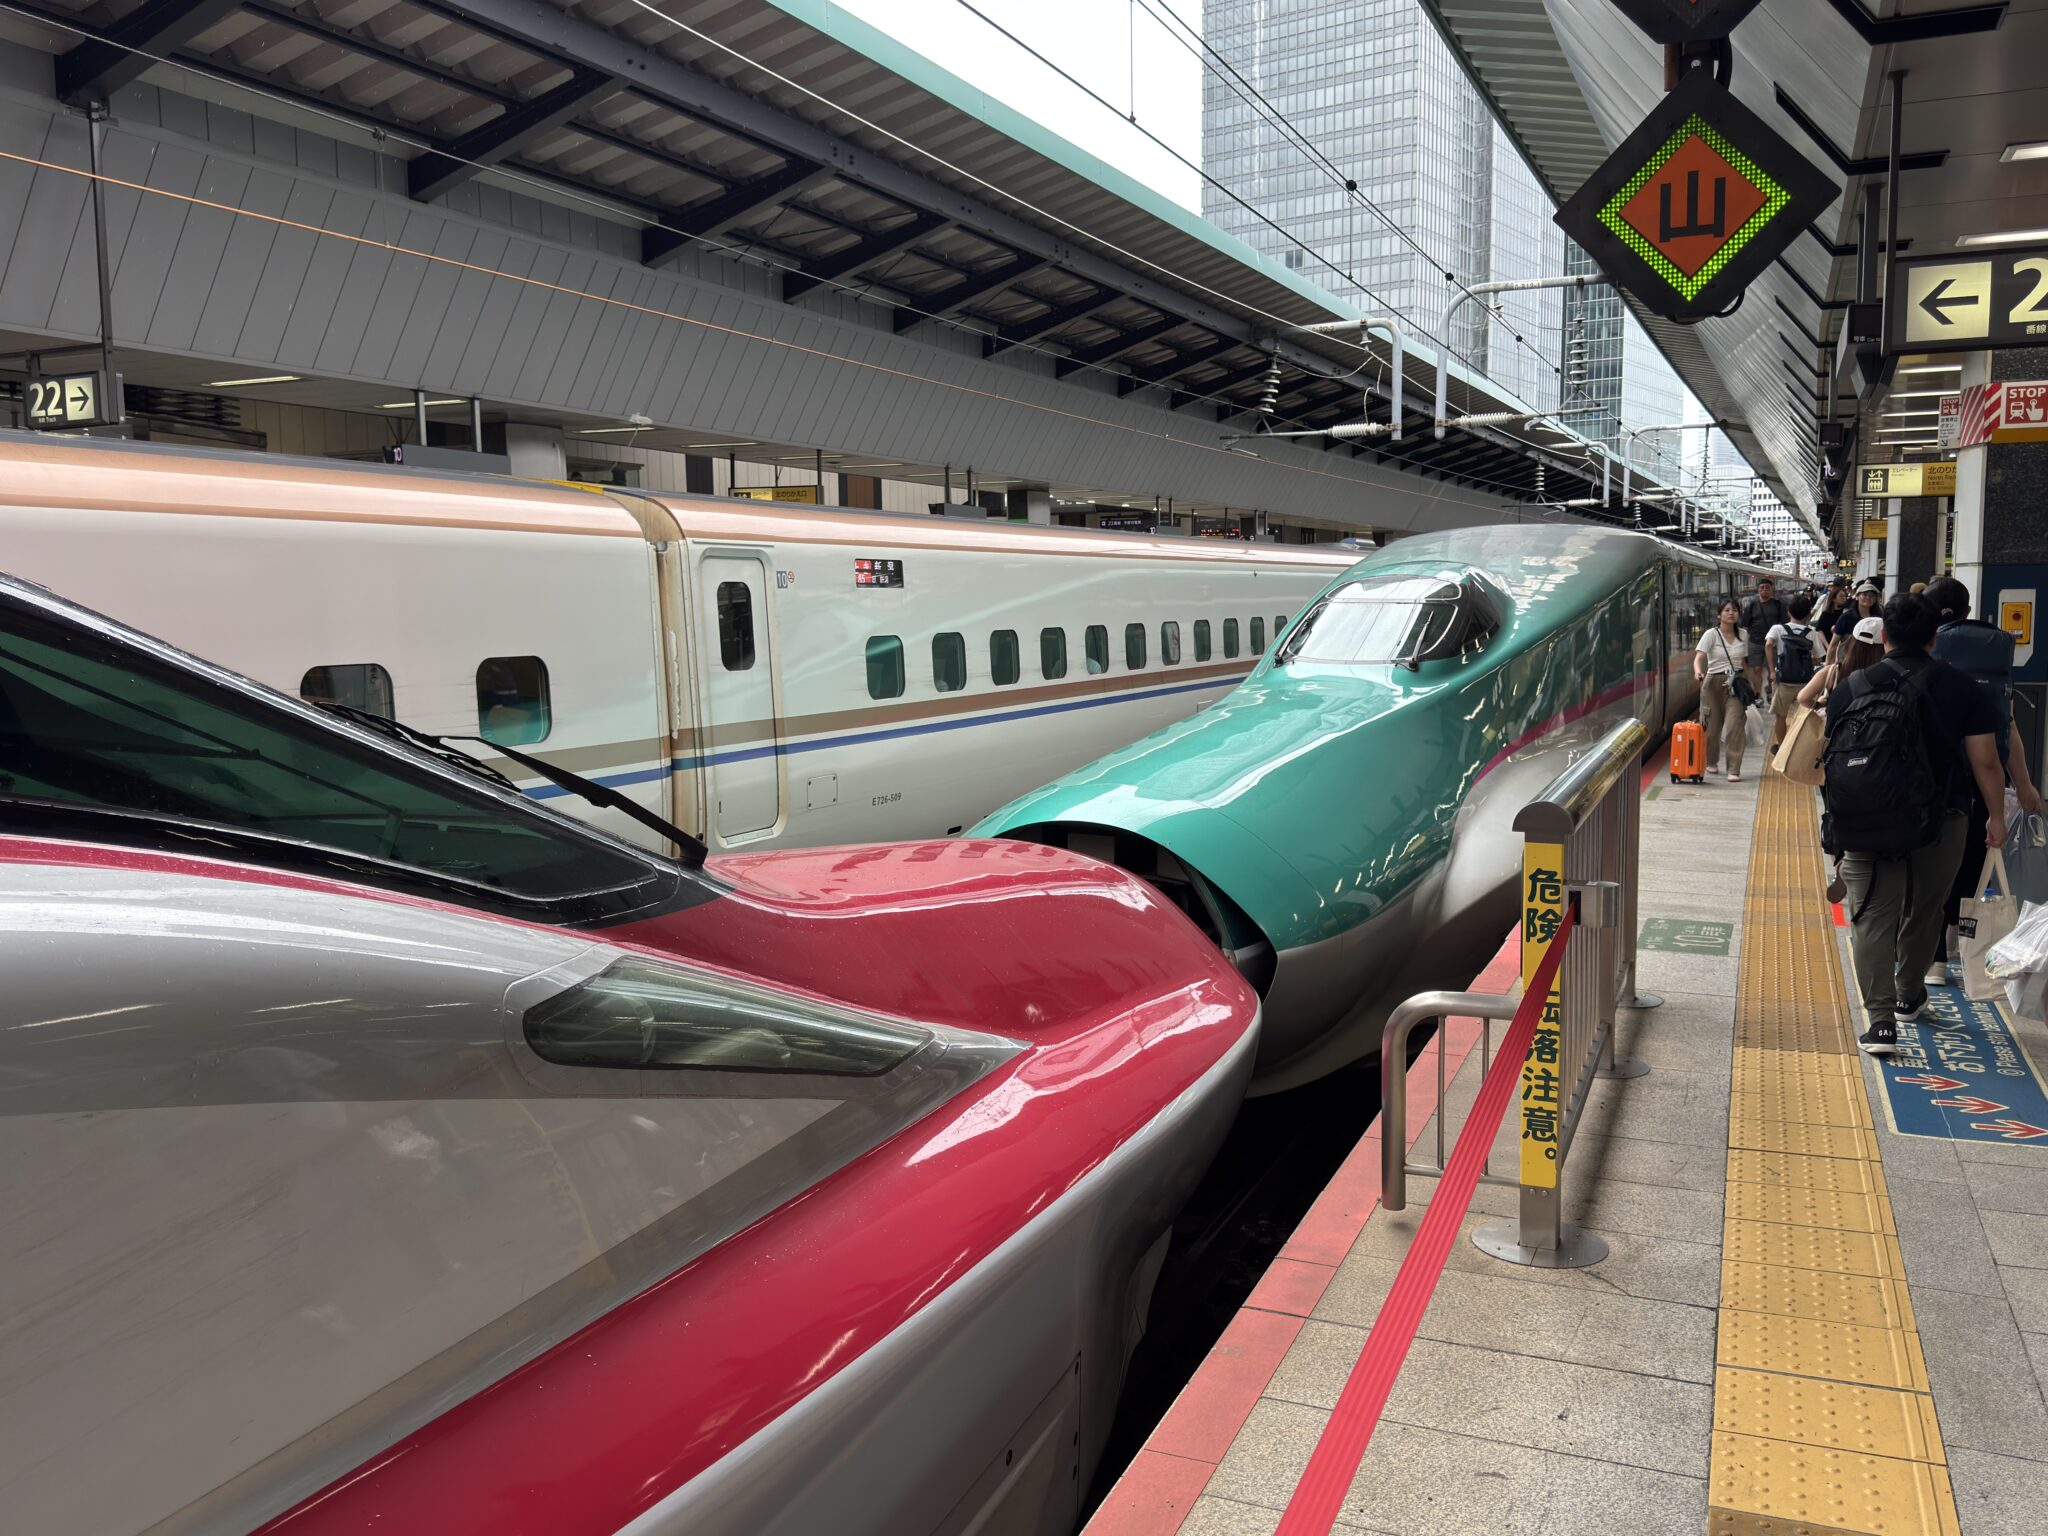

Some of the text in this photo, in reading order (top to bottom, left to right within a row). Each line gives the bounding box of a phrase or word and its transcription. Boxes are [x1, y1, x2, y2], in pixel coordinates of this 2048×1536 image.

[2009, 257, 2048, 323] 2
[2026, 325, 2047, 334] 番線
[29, 381, 63, 417] 22
[2009, 387, 2046, 399] STOP
[778, 573, 787, 587] 10
[1526, 867, 1562, 944] 危険
[1971, 1010, 2001, 1032] behind
[1985, 1031, 2010, 1046] stay
[1994, 1045, 2020, 1068] Please
